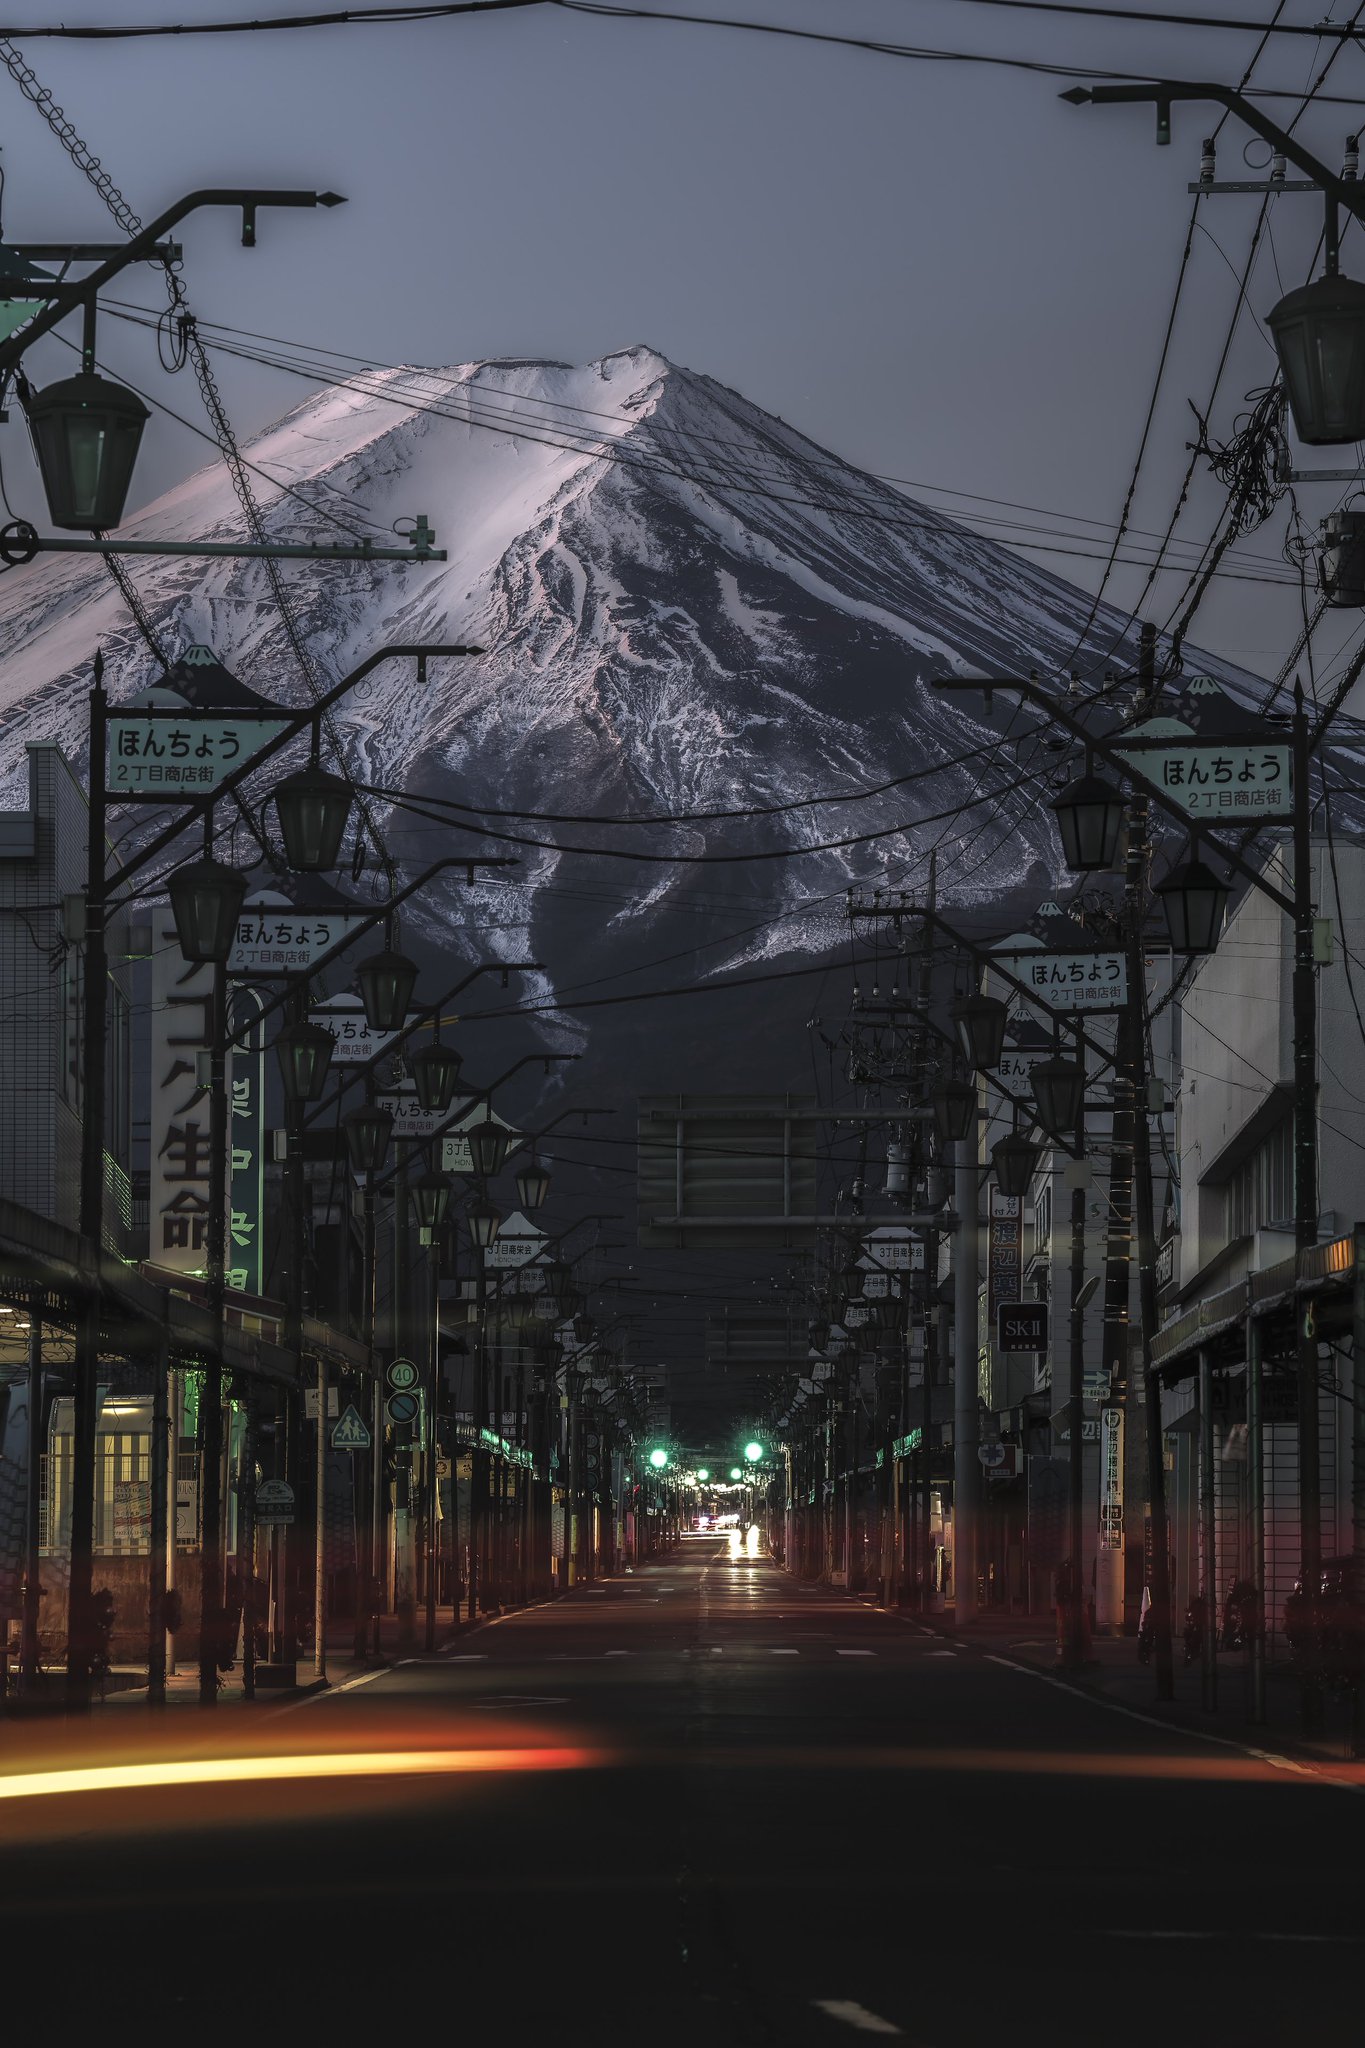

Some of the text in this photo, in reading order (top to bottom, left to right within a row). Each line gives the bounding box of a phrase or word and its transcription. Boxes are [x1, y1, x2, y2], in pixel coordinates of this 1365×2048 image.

[118, 729, 240, 760] ほんちょう
[117, 764, 214, 783] 2丁目商店街
[1163, 754, 1281, 786] ほんちょう
[1188, 788, 1282, 809] 2丁目商店街
[236, 923, 330, 946] ほんちょう
[1031, 959, 1121, 985] ほんちょう
[394, 1368, 412, 1383] 40
